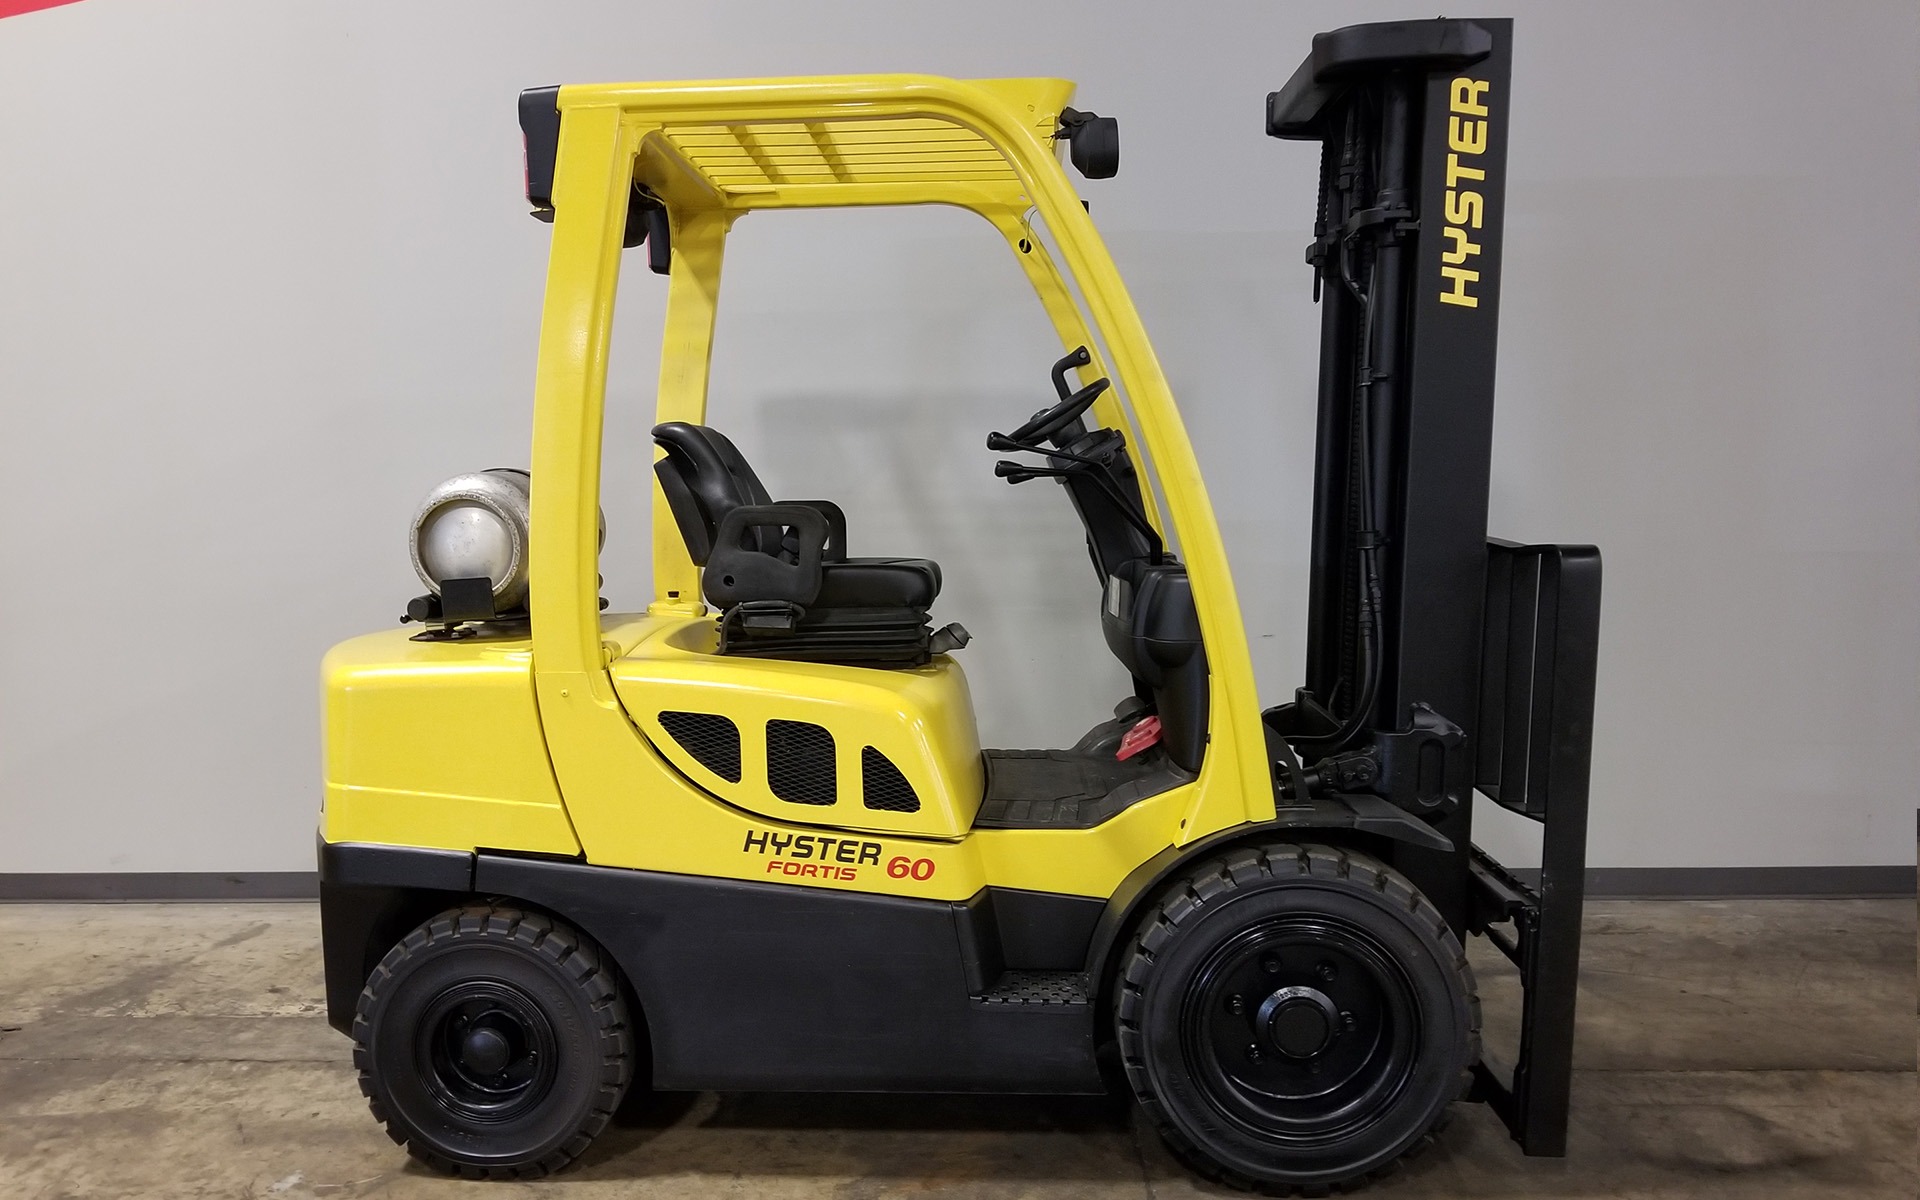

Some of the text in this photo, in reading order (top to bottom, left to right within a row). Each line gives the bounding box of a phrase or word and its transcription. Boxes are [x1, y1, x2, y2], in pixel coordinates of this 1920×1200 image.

[1440, 77, 1490, 308] HYSTER
[743, 830, 882, 866] HYSTER
[766, 860, 858, 881] FORTIS
[886, 856, 936, 881] 60
